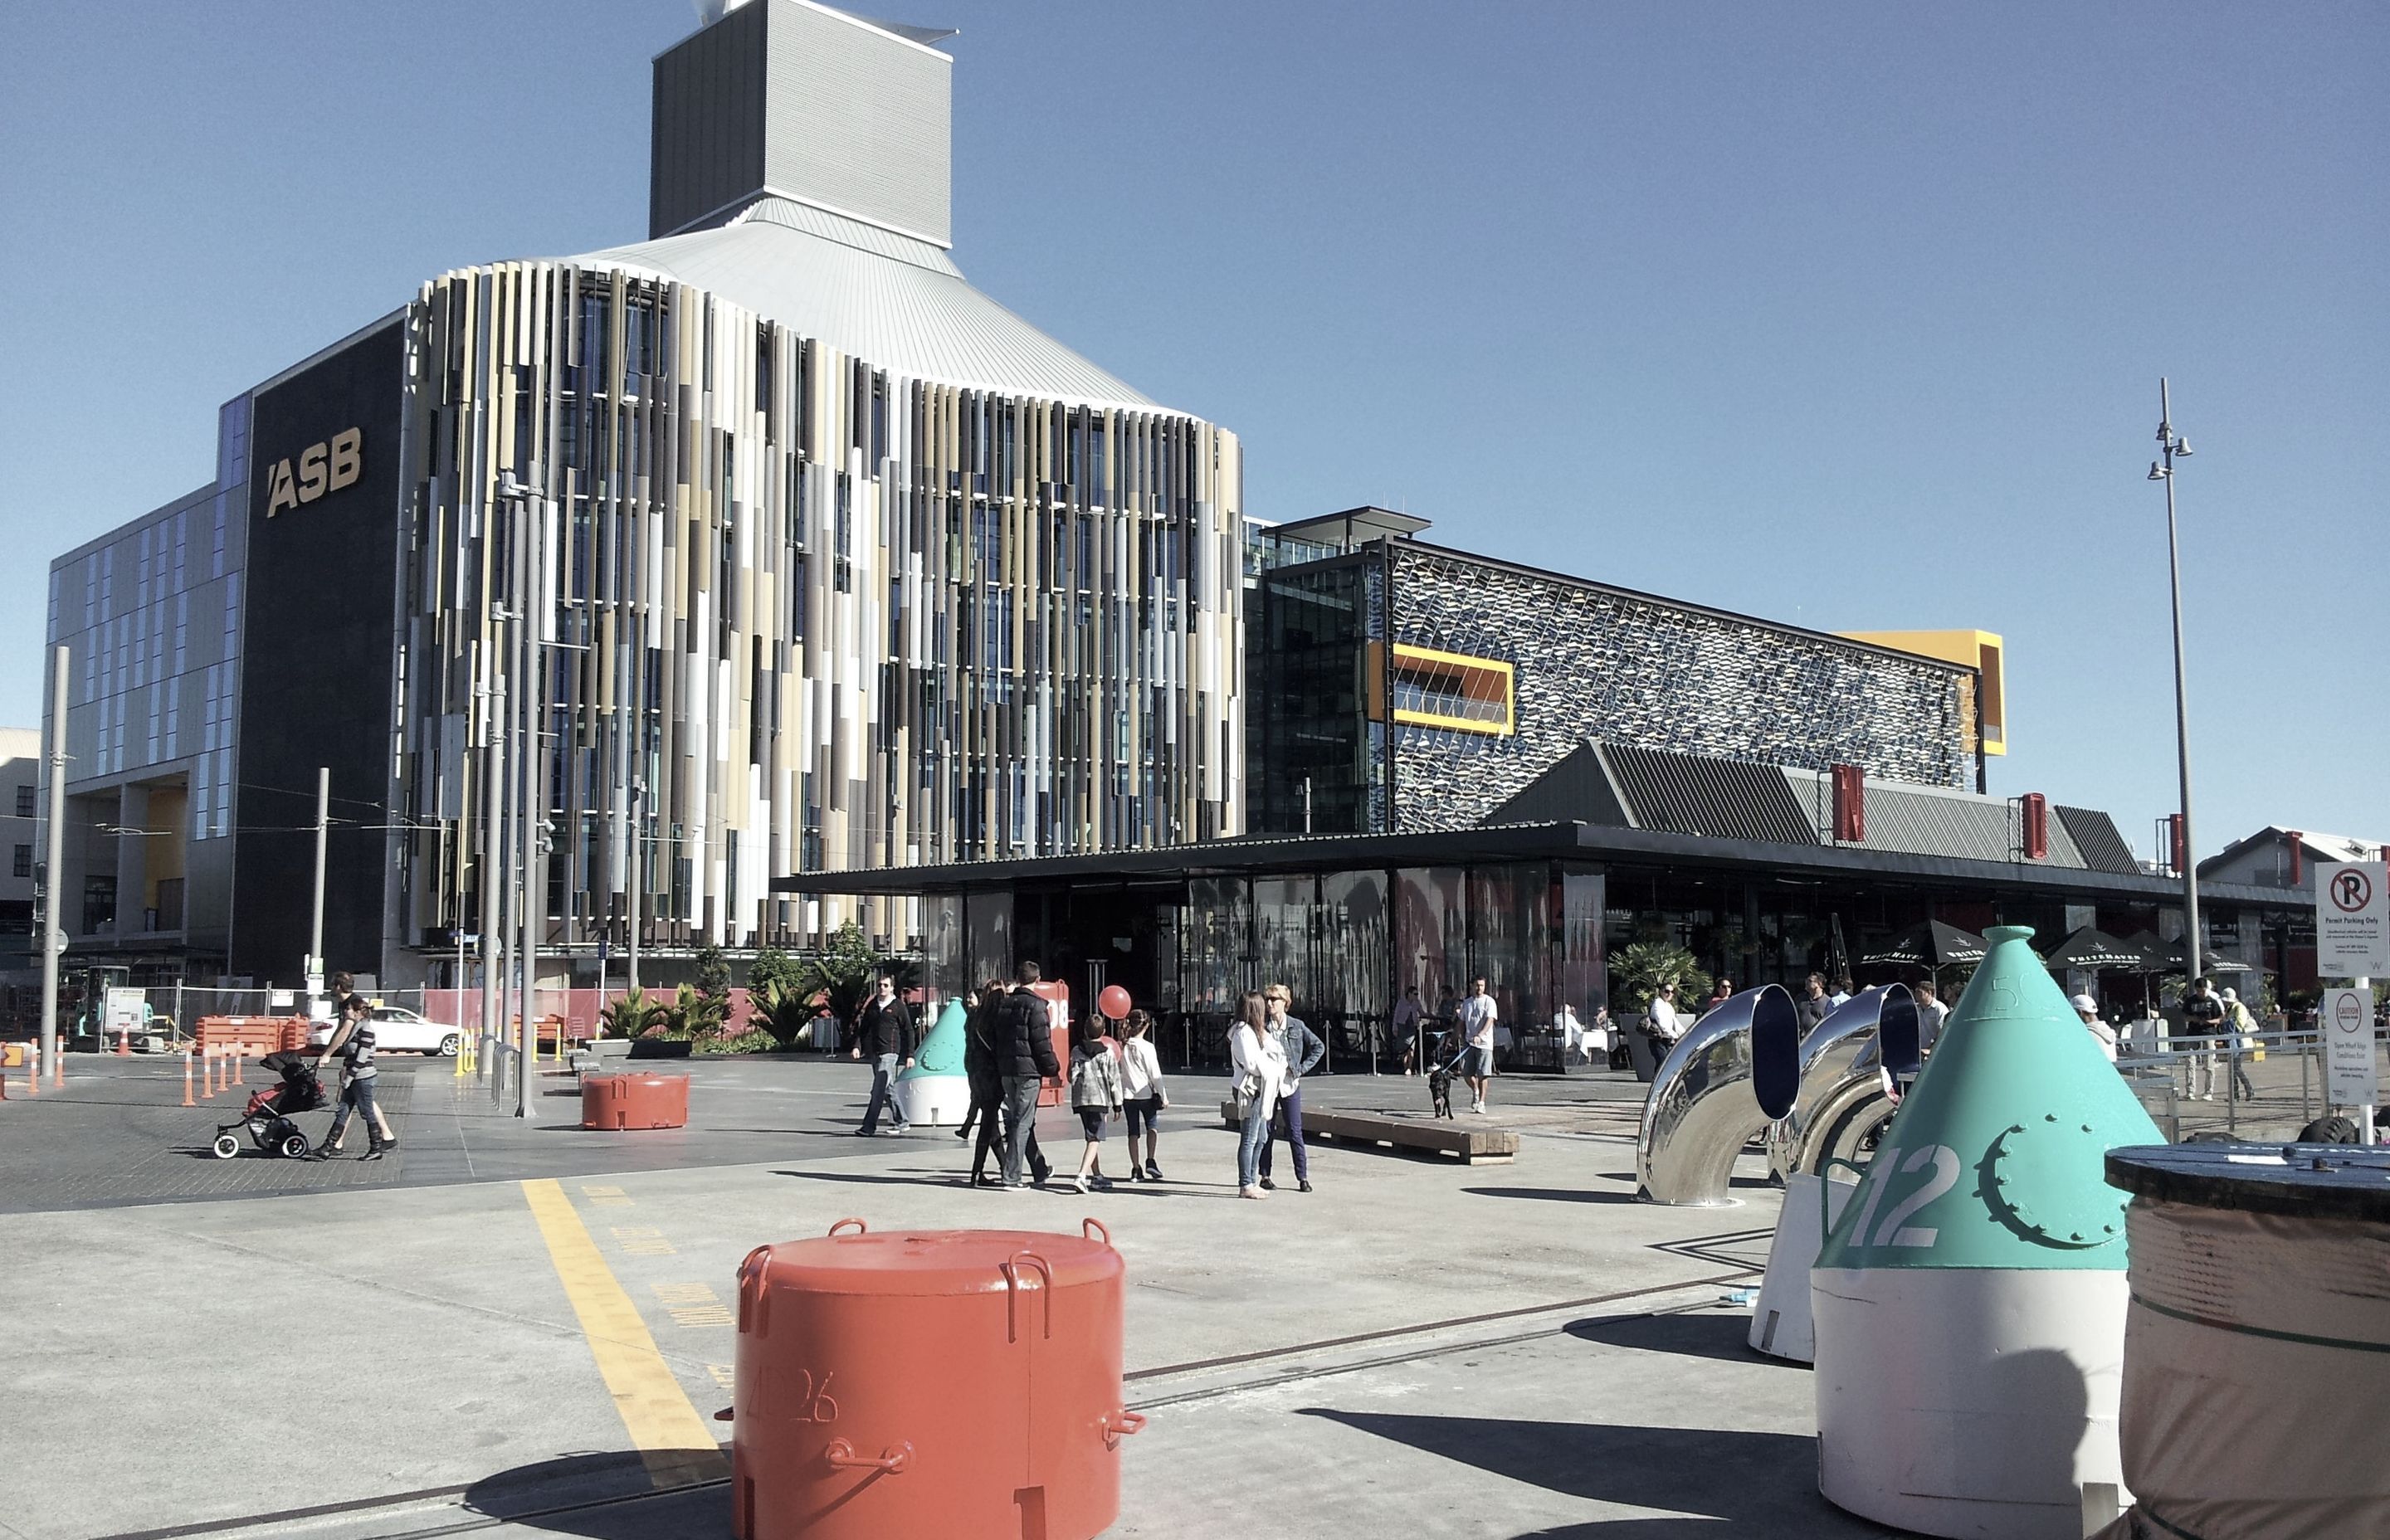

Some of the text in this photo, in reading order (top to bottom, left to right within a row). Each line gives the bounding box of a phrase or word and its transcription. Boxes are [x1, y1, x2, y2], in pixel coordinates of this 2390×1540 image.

[267, 426, 362, 518] ASB
[2344, 917, 2364, 925] Parking
[2066, 953, 2141, 962] WHITEHAVEN
[1848, 1144, 1961, 1247] 12
